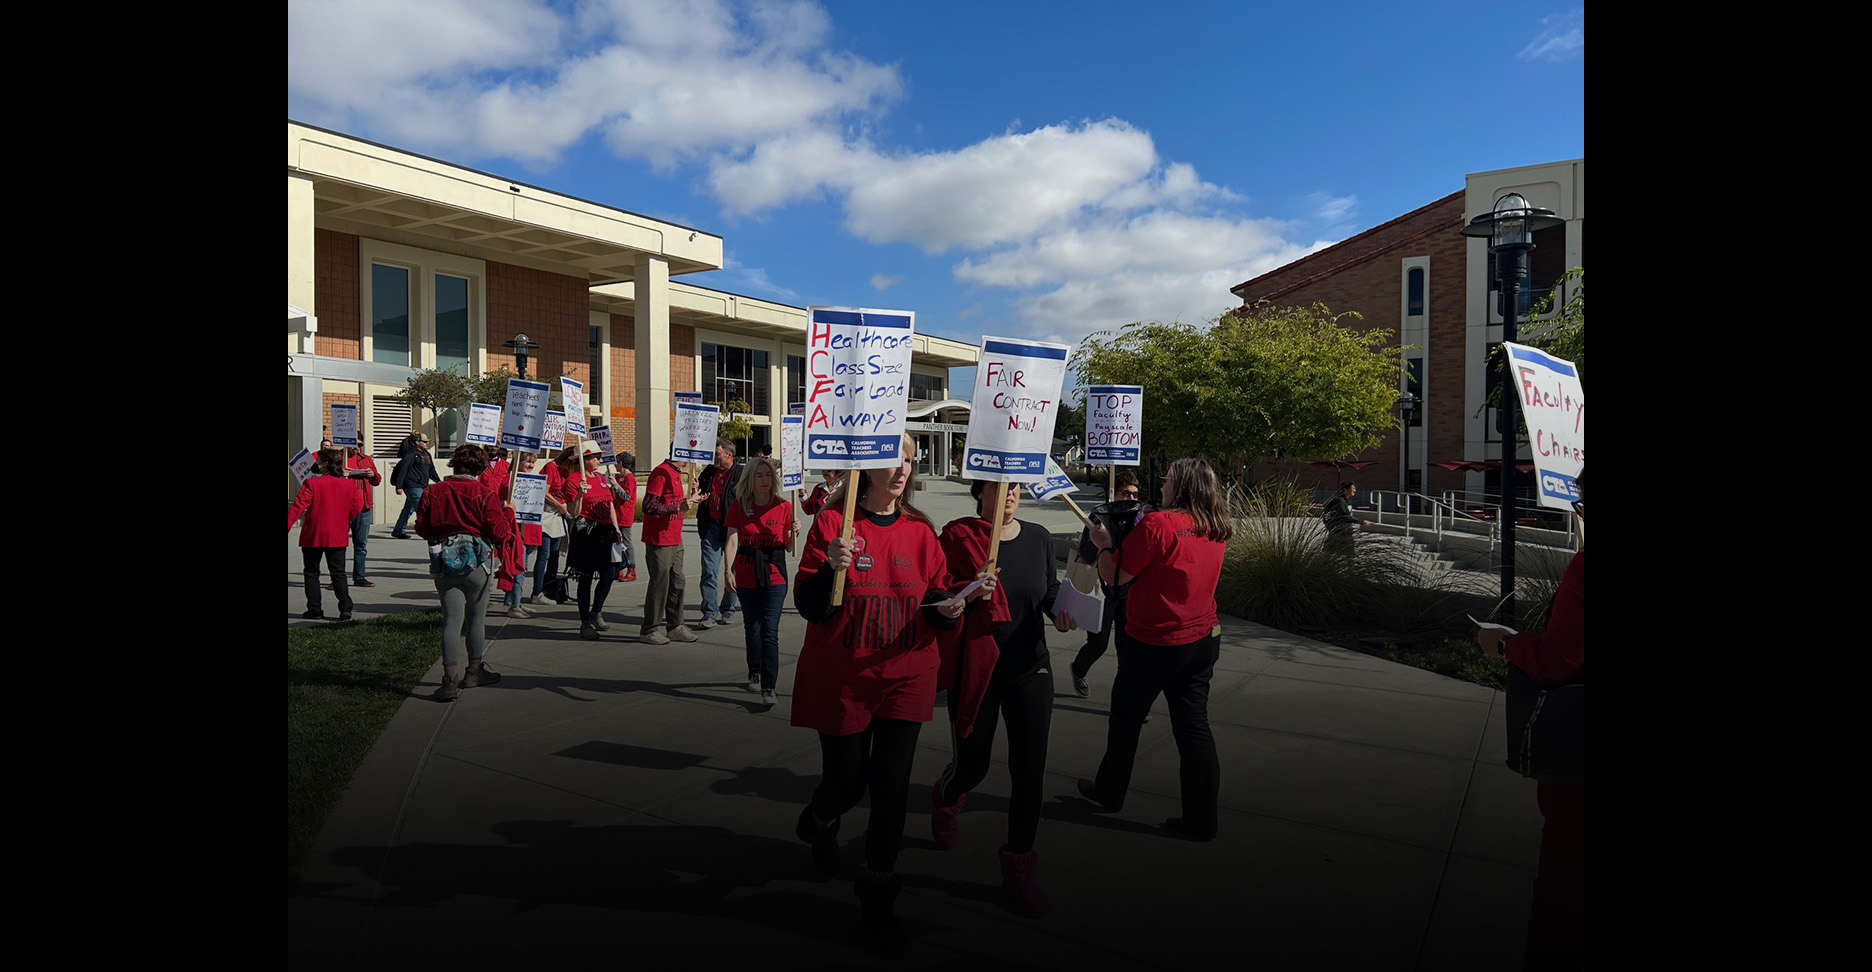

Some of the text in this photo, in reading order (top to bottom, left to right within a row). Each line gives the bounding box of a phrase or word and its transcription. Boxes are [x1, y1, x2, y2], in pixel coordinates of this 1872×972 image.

[811, 323, 913, 350] Healthcare
[810, 350, 903, 379] Class Size
[986, 362, 1026, 388] FAIR
[509, 388, 540, 402] Teachers
[809, 379, 904, 403] Fair Load
[993, 392, 1051, 413] CONTRACT
[1091, 394, 1132, 409] TOP
[1093, 410, 1132, 423] Faculty
[1095, 423, 1133, 432] Payscale
[502, 435, 516, 443] CTA
[1087, 432, 1140, 446] BOTTOM
[810, 439, 849, 455] CTA
[881, 443, 894, 452] nea
[1089, 449, 1108, 457] CTA
[969, 453, 1002, 469] CTA
[1028, 460, 1040, 468] nea
[1543, 474, 1570, 496] CTA
[842, 594, 918, 650] STRONG
